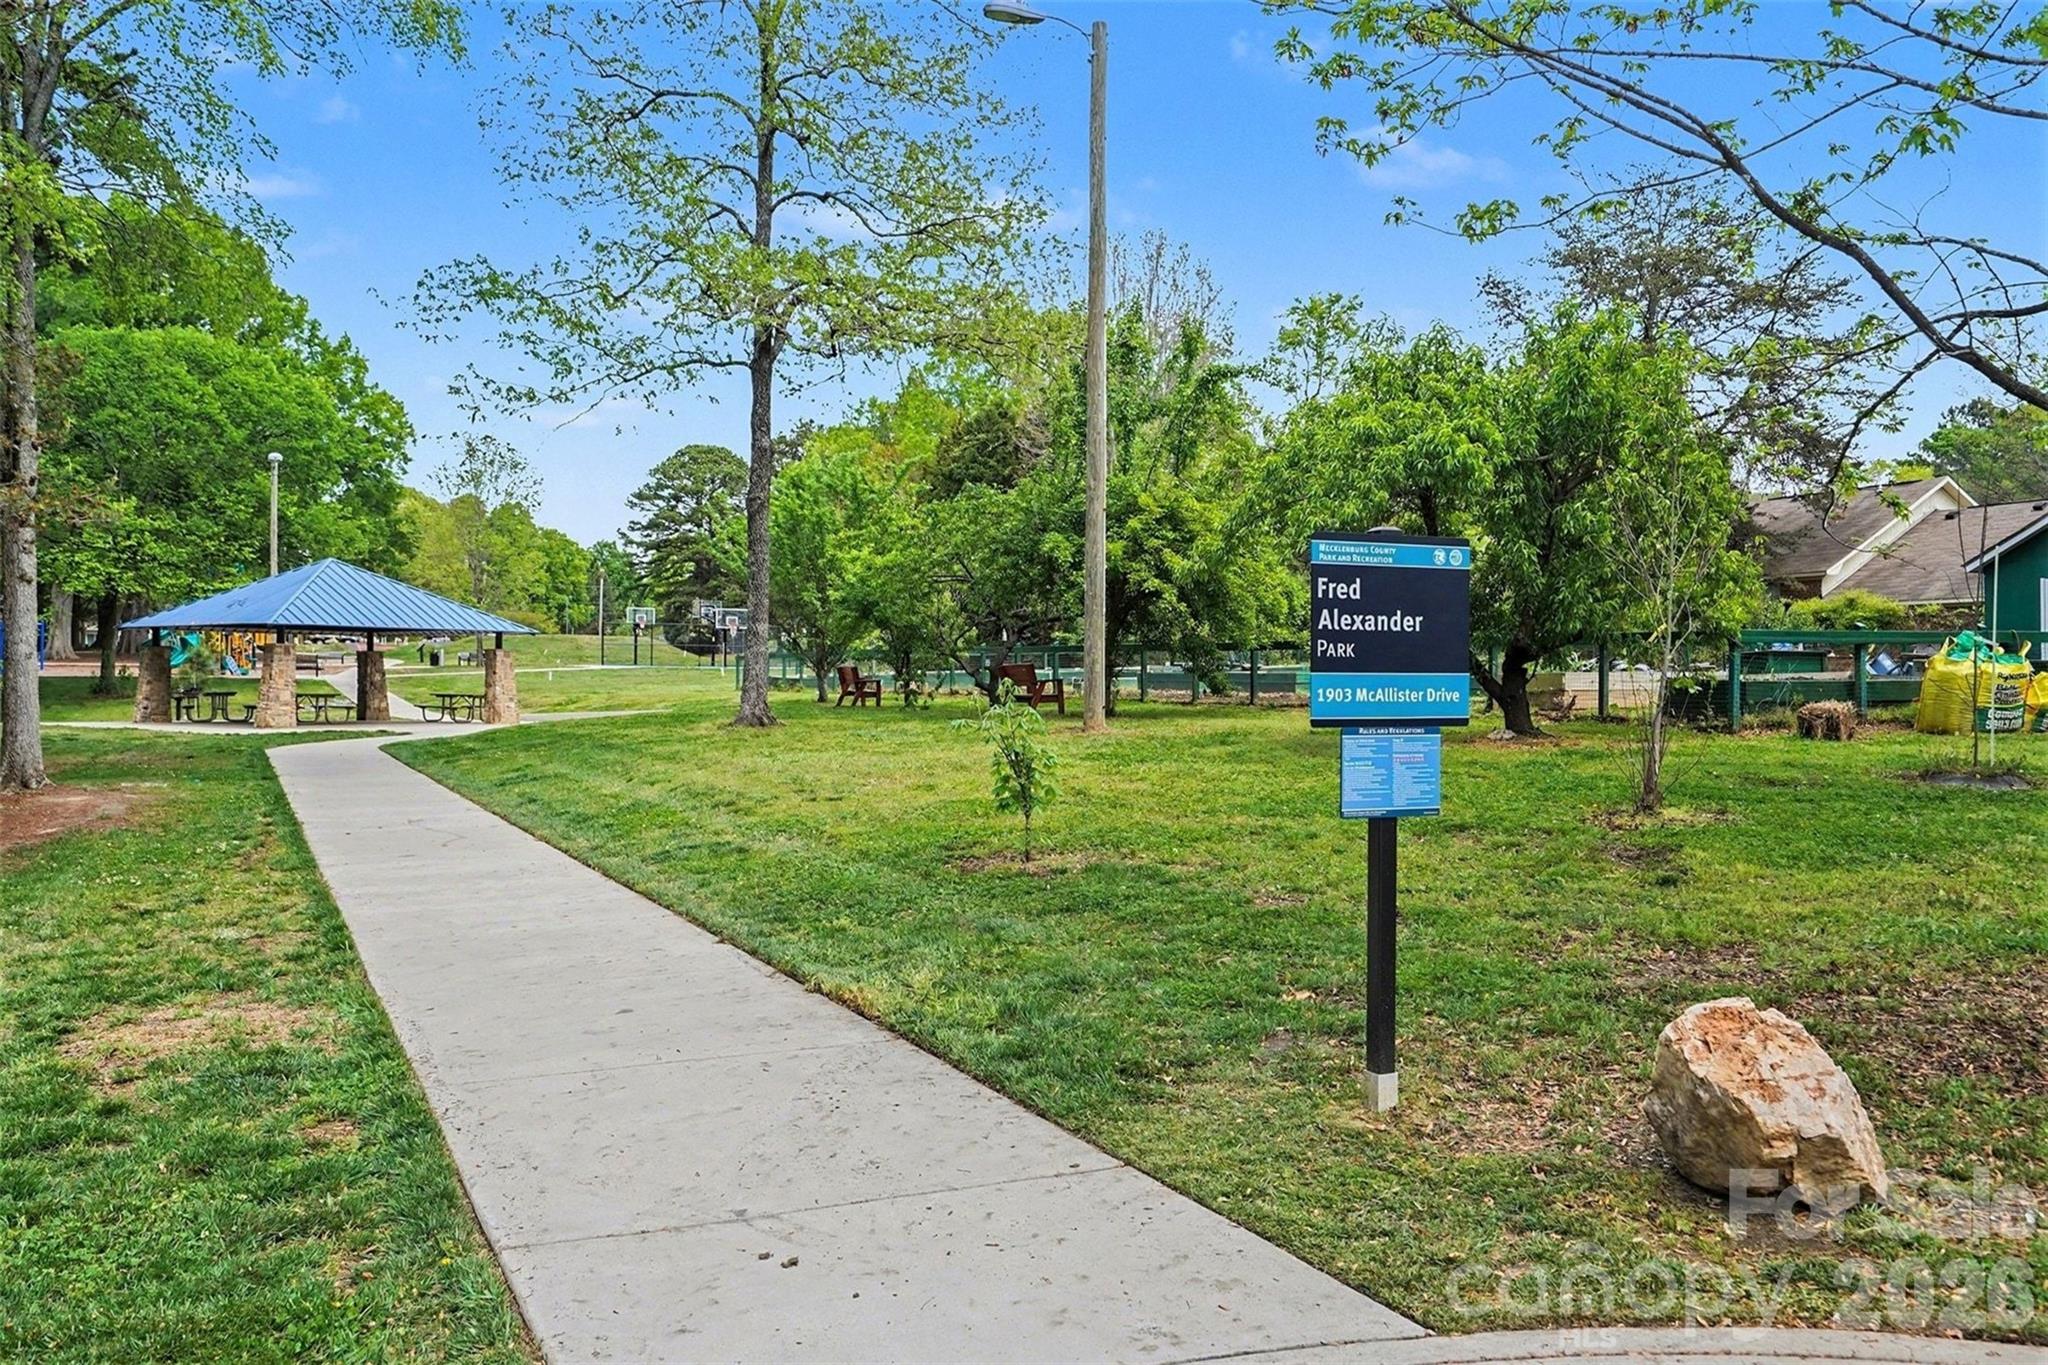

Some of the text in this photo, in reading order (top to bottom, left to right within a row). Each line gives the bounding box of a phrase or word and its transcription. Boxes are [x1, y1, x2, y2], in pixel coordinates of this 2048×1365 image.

[1319, 553, 1336, 561] PARK
[1352, 554, 1393, 564] RECREATION
[1370, 545, 1396, 555] COUNTY
[1317, 577, 1361, 600] Fred
[1318, 608, 1423, 632] Alexander
[1317, 639, 1355, 657] PARK
[1317, 687, 1460, 703] 1903 McAllister Drive
